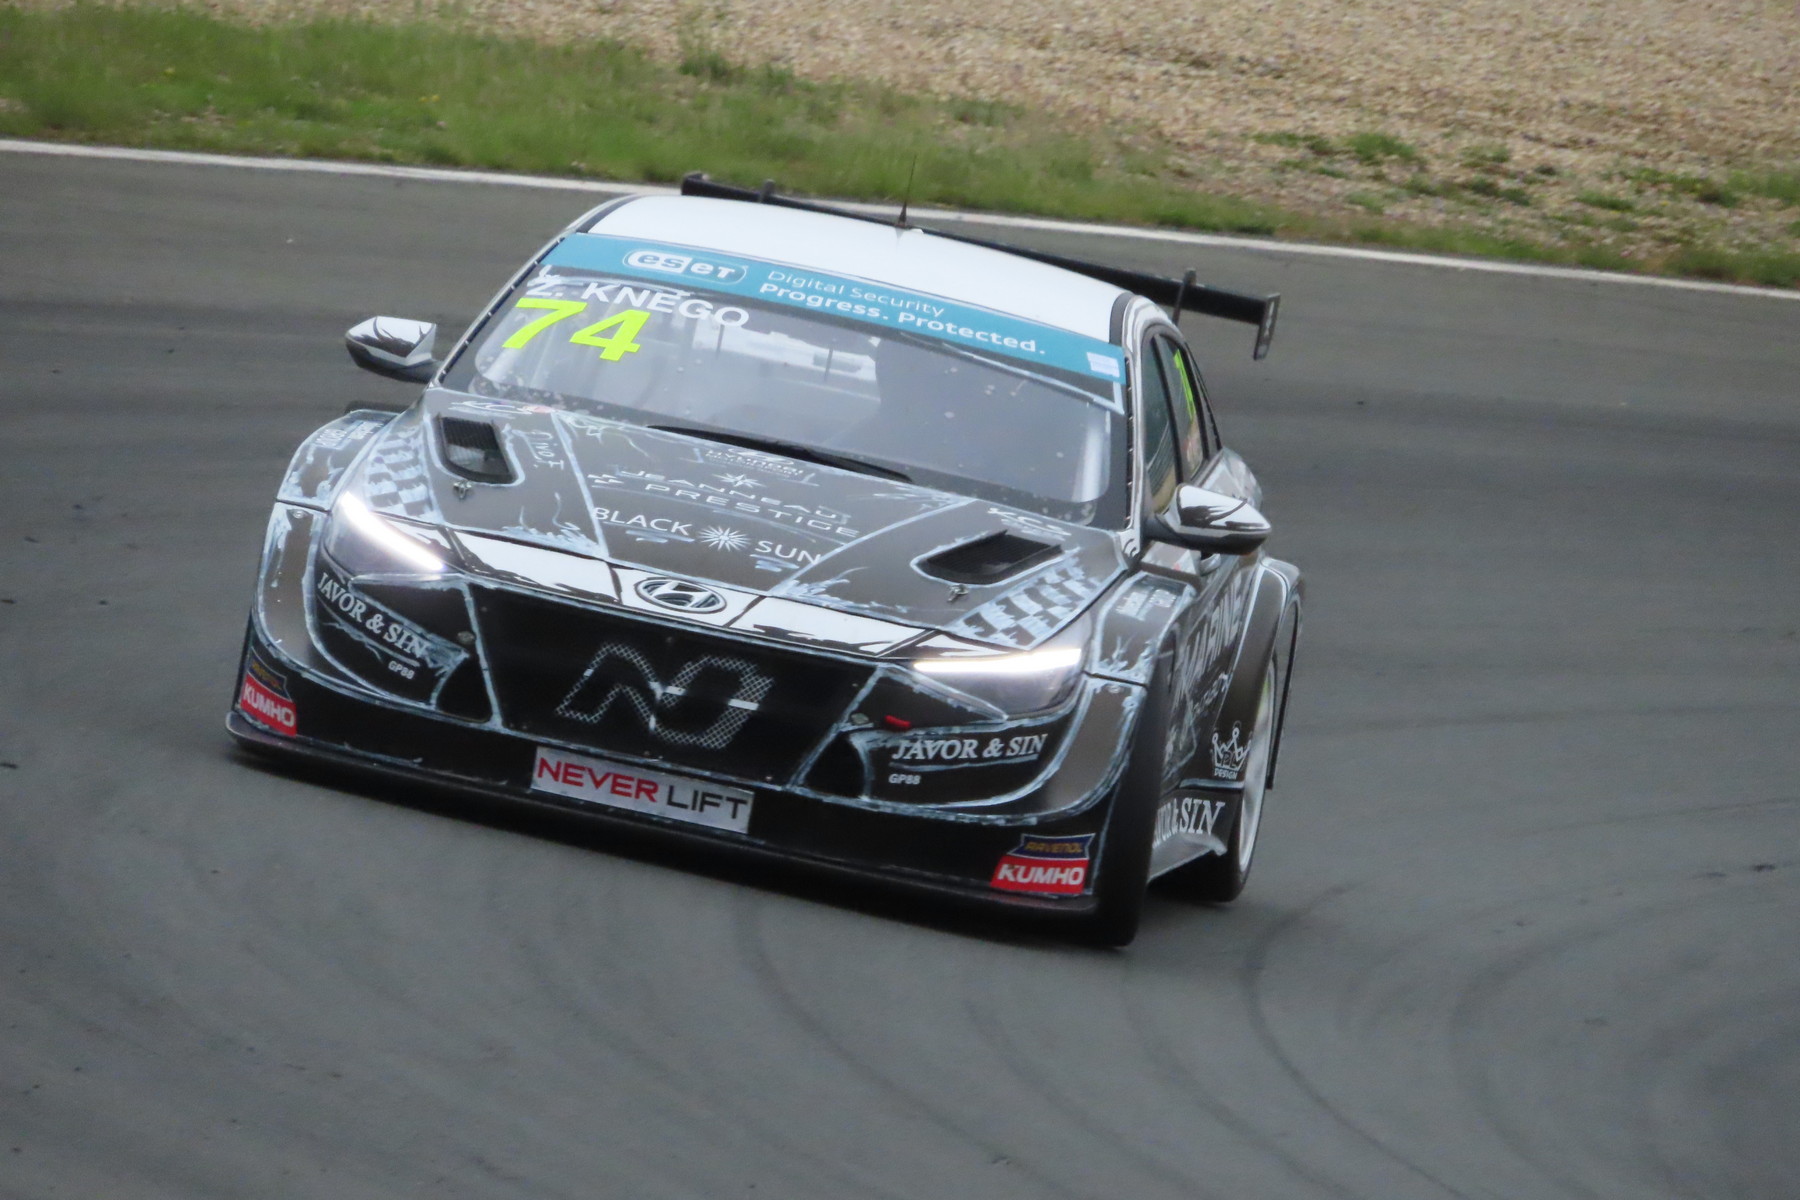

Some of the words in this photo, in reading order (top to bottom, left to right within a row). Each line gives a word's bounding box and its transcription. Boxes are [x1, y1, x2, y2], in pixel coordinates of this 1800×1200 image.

[580, 282, 749, 328] KNEGO
[759, 282, 889, 321] Progress.
[898, 311, 1045, 354] Protected.
[767, 270, 845, 295] Digital
[851, 287, 945, 318] Security
[502, 297, 651, 361] 74
[592, 506, 693, 536] BLACK
[754, 540, 822, 565] SUN
[645, 483, 860, 538] PRESTIGE
[317, 572, 367, 623] JAVOR
[365, 613, 385, 634] &
[242, 685, 296, 728] KUMHO
[891, 735, 978, 761] JAVOR
[982, 737, 1004, 759] &
[1006, 733, 1049, 757] SIN
[537, 757, 660, 803] NEVER
[666, 784, 748, 820] LIFT
[1179, 797, 1226, 837] SIN
[997, 862, 1085, 886] KUMHO
